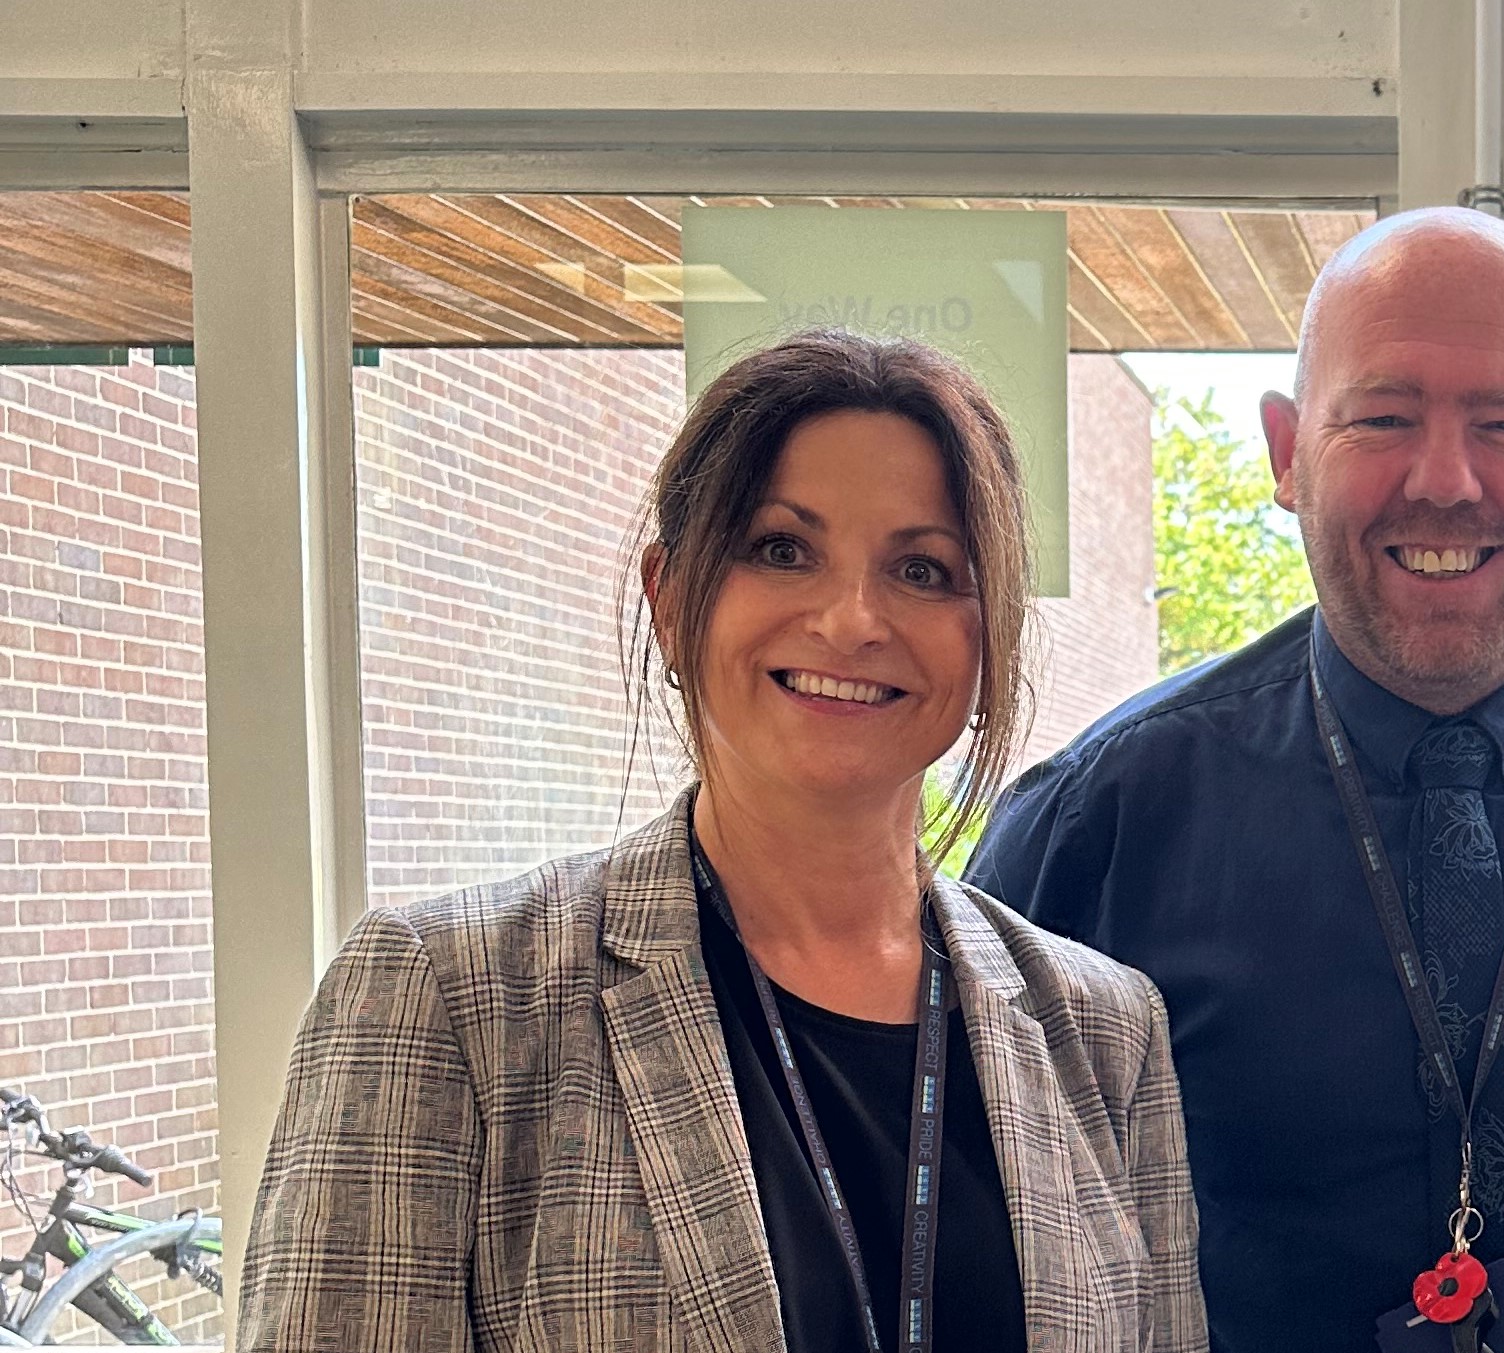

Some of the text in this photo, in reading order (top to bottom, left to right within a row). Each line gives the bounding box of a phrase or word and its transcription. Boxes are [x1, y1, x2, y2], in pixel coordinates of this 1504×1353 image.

[1374, 872, 1408, 948] CHALLENGE
[1412, 983, 1440, 1047] RESPECT
[924, 1009, 941, 1073] RESPECT
[792, 1078, 826, 1166] CHALLENGE
[918, 1118, 935, 1161] PRIDE
[911, 1209, 929, 1294] CREATIVITY
